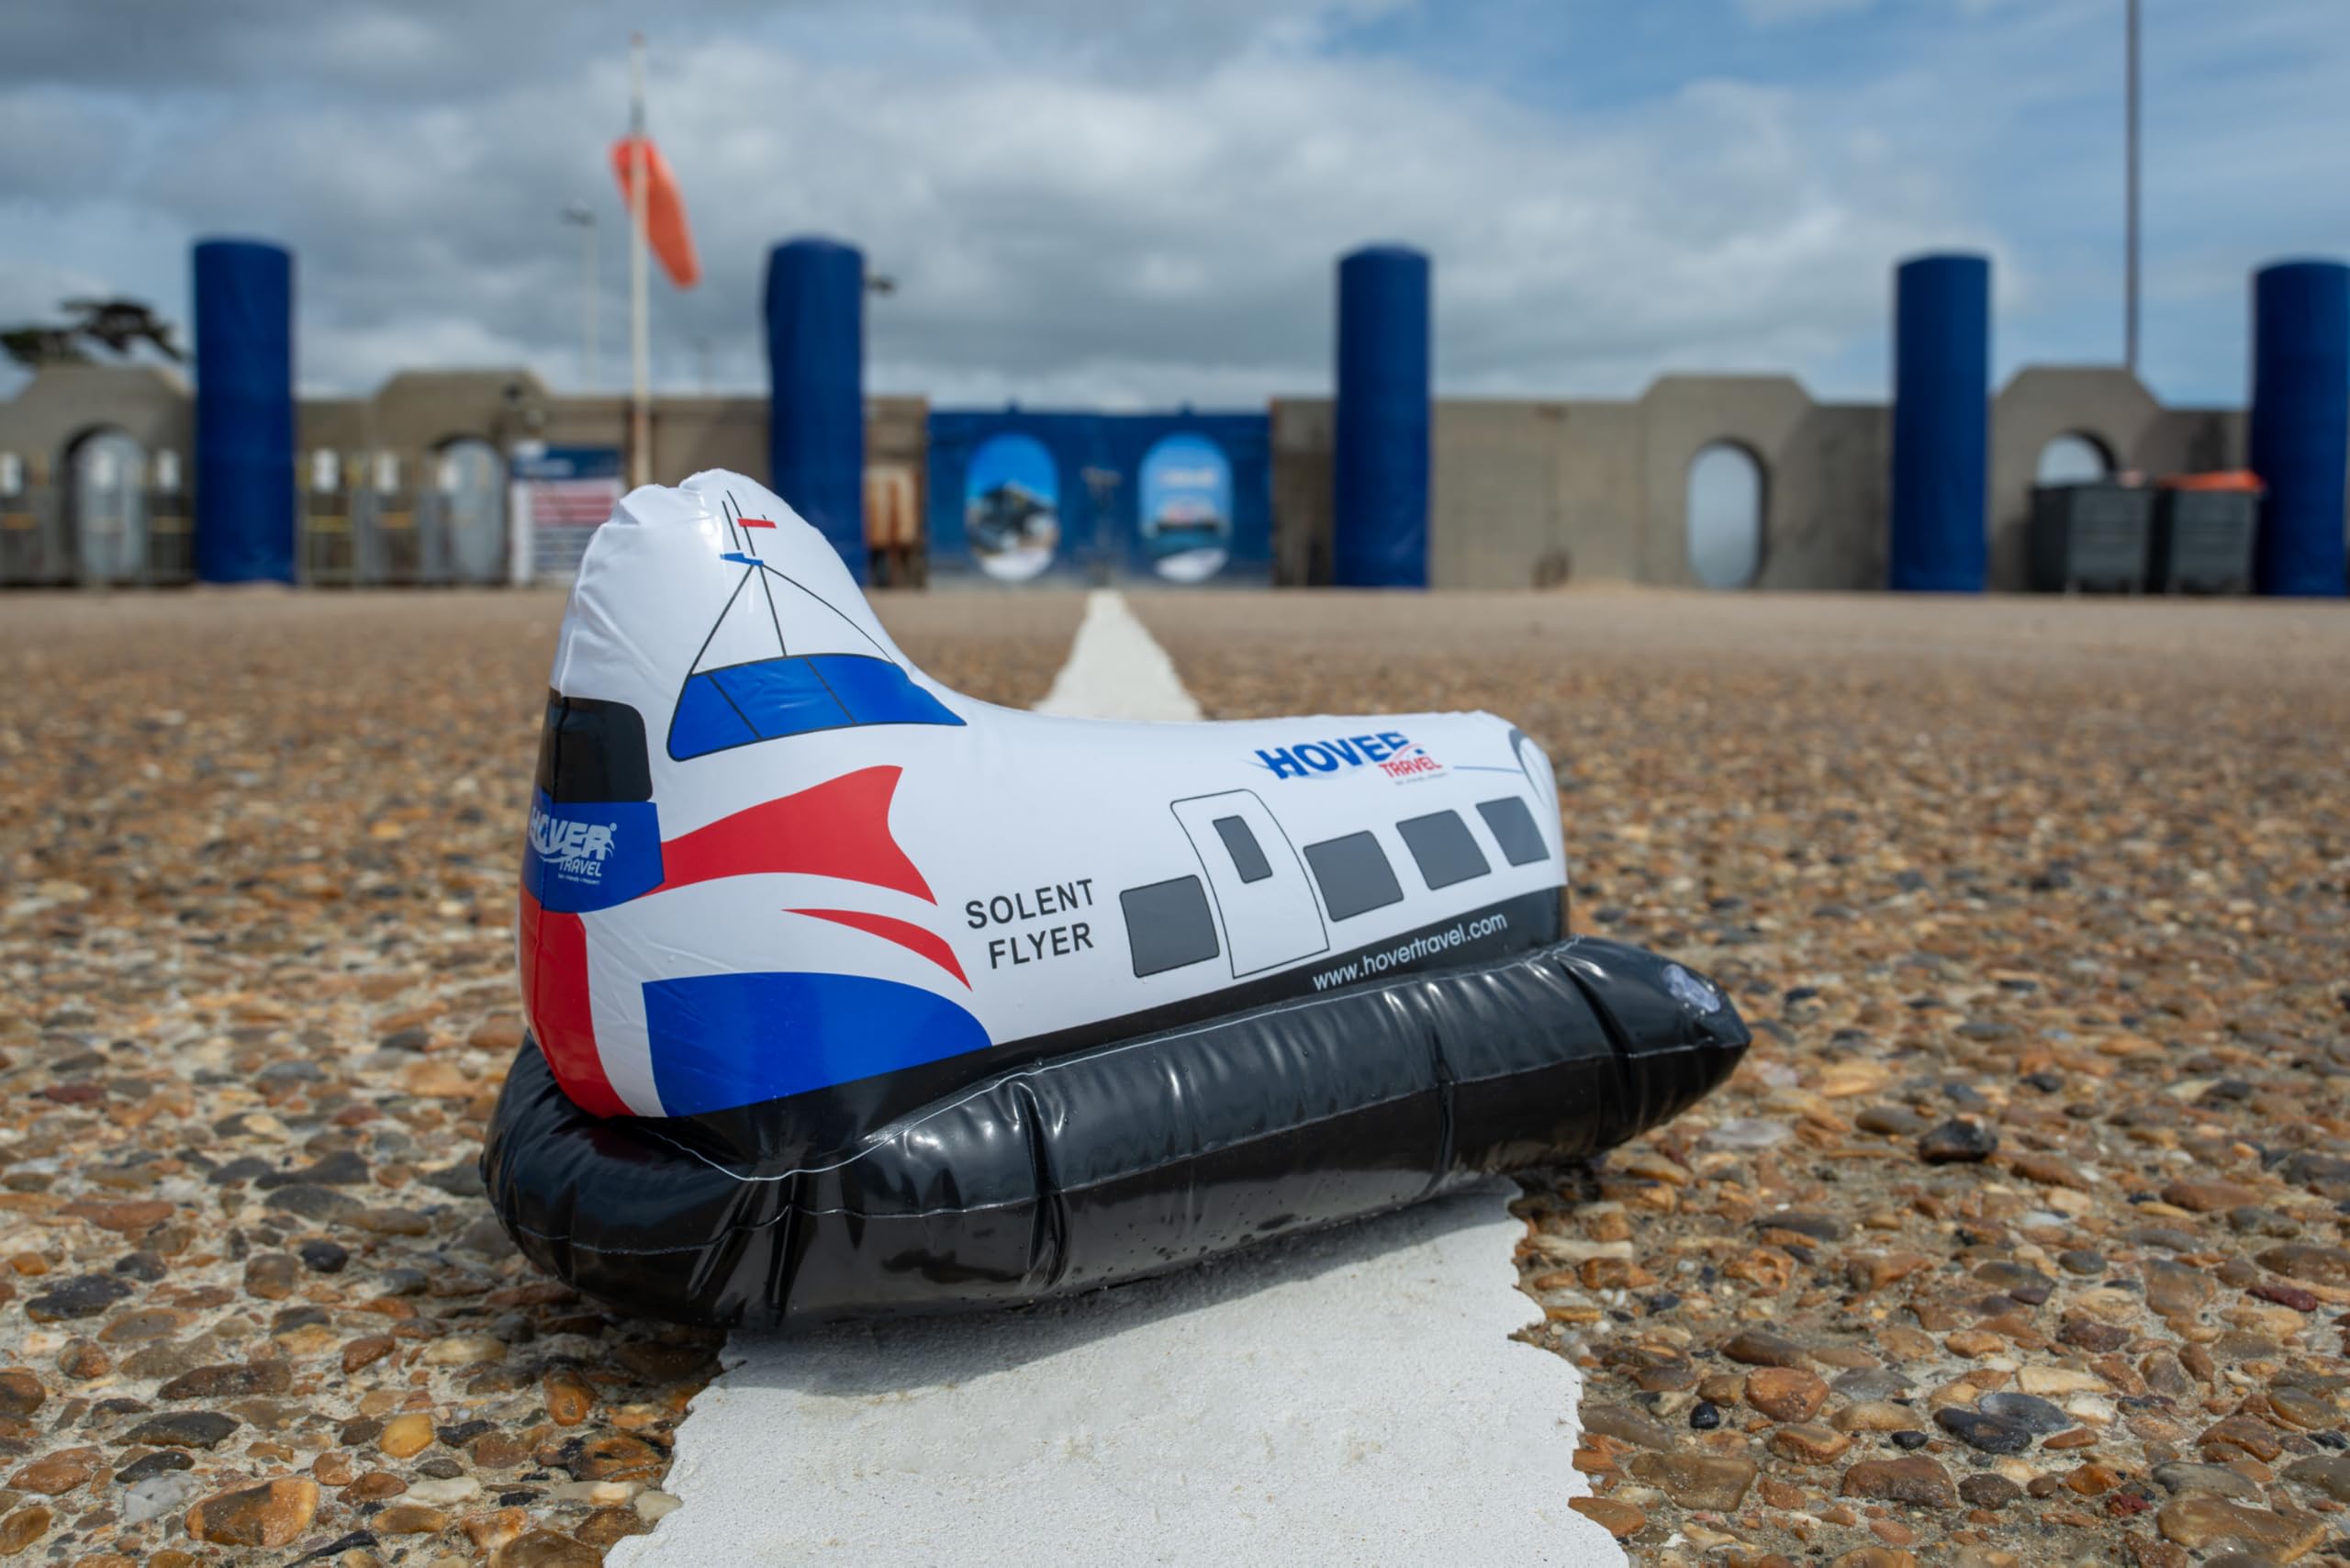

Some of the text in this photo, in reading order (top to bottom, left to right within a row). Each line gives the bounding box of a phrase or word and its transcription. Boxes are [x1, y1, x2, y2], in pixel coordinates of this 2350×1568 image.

[1379, 756, 1443, 778] TRAVEL
[530, 806, 612, 860] HOVER
[559, 857, 602, 878] TRAVEL
[965, 878, 1093, 929] SOLENT
[989, 922, 1094, 969] FLYER
[1313, 913, 1508, 991] www.hovertravel.com
